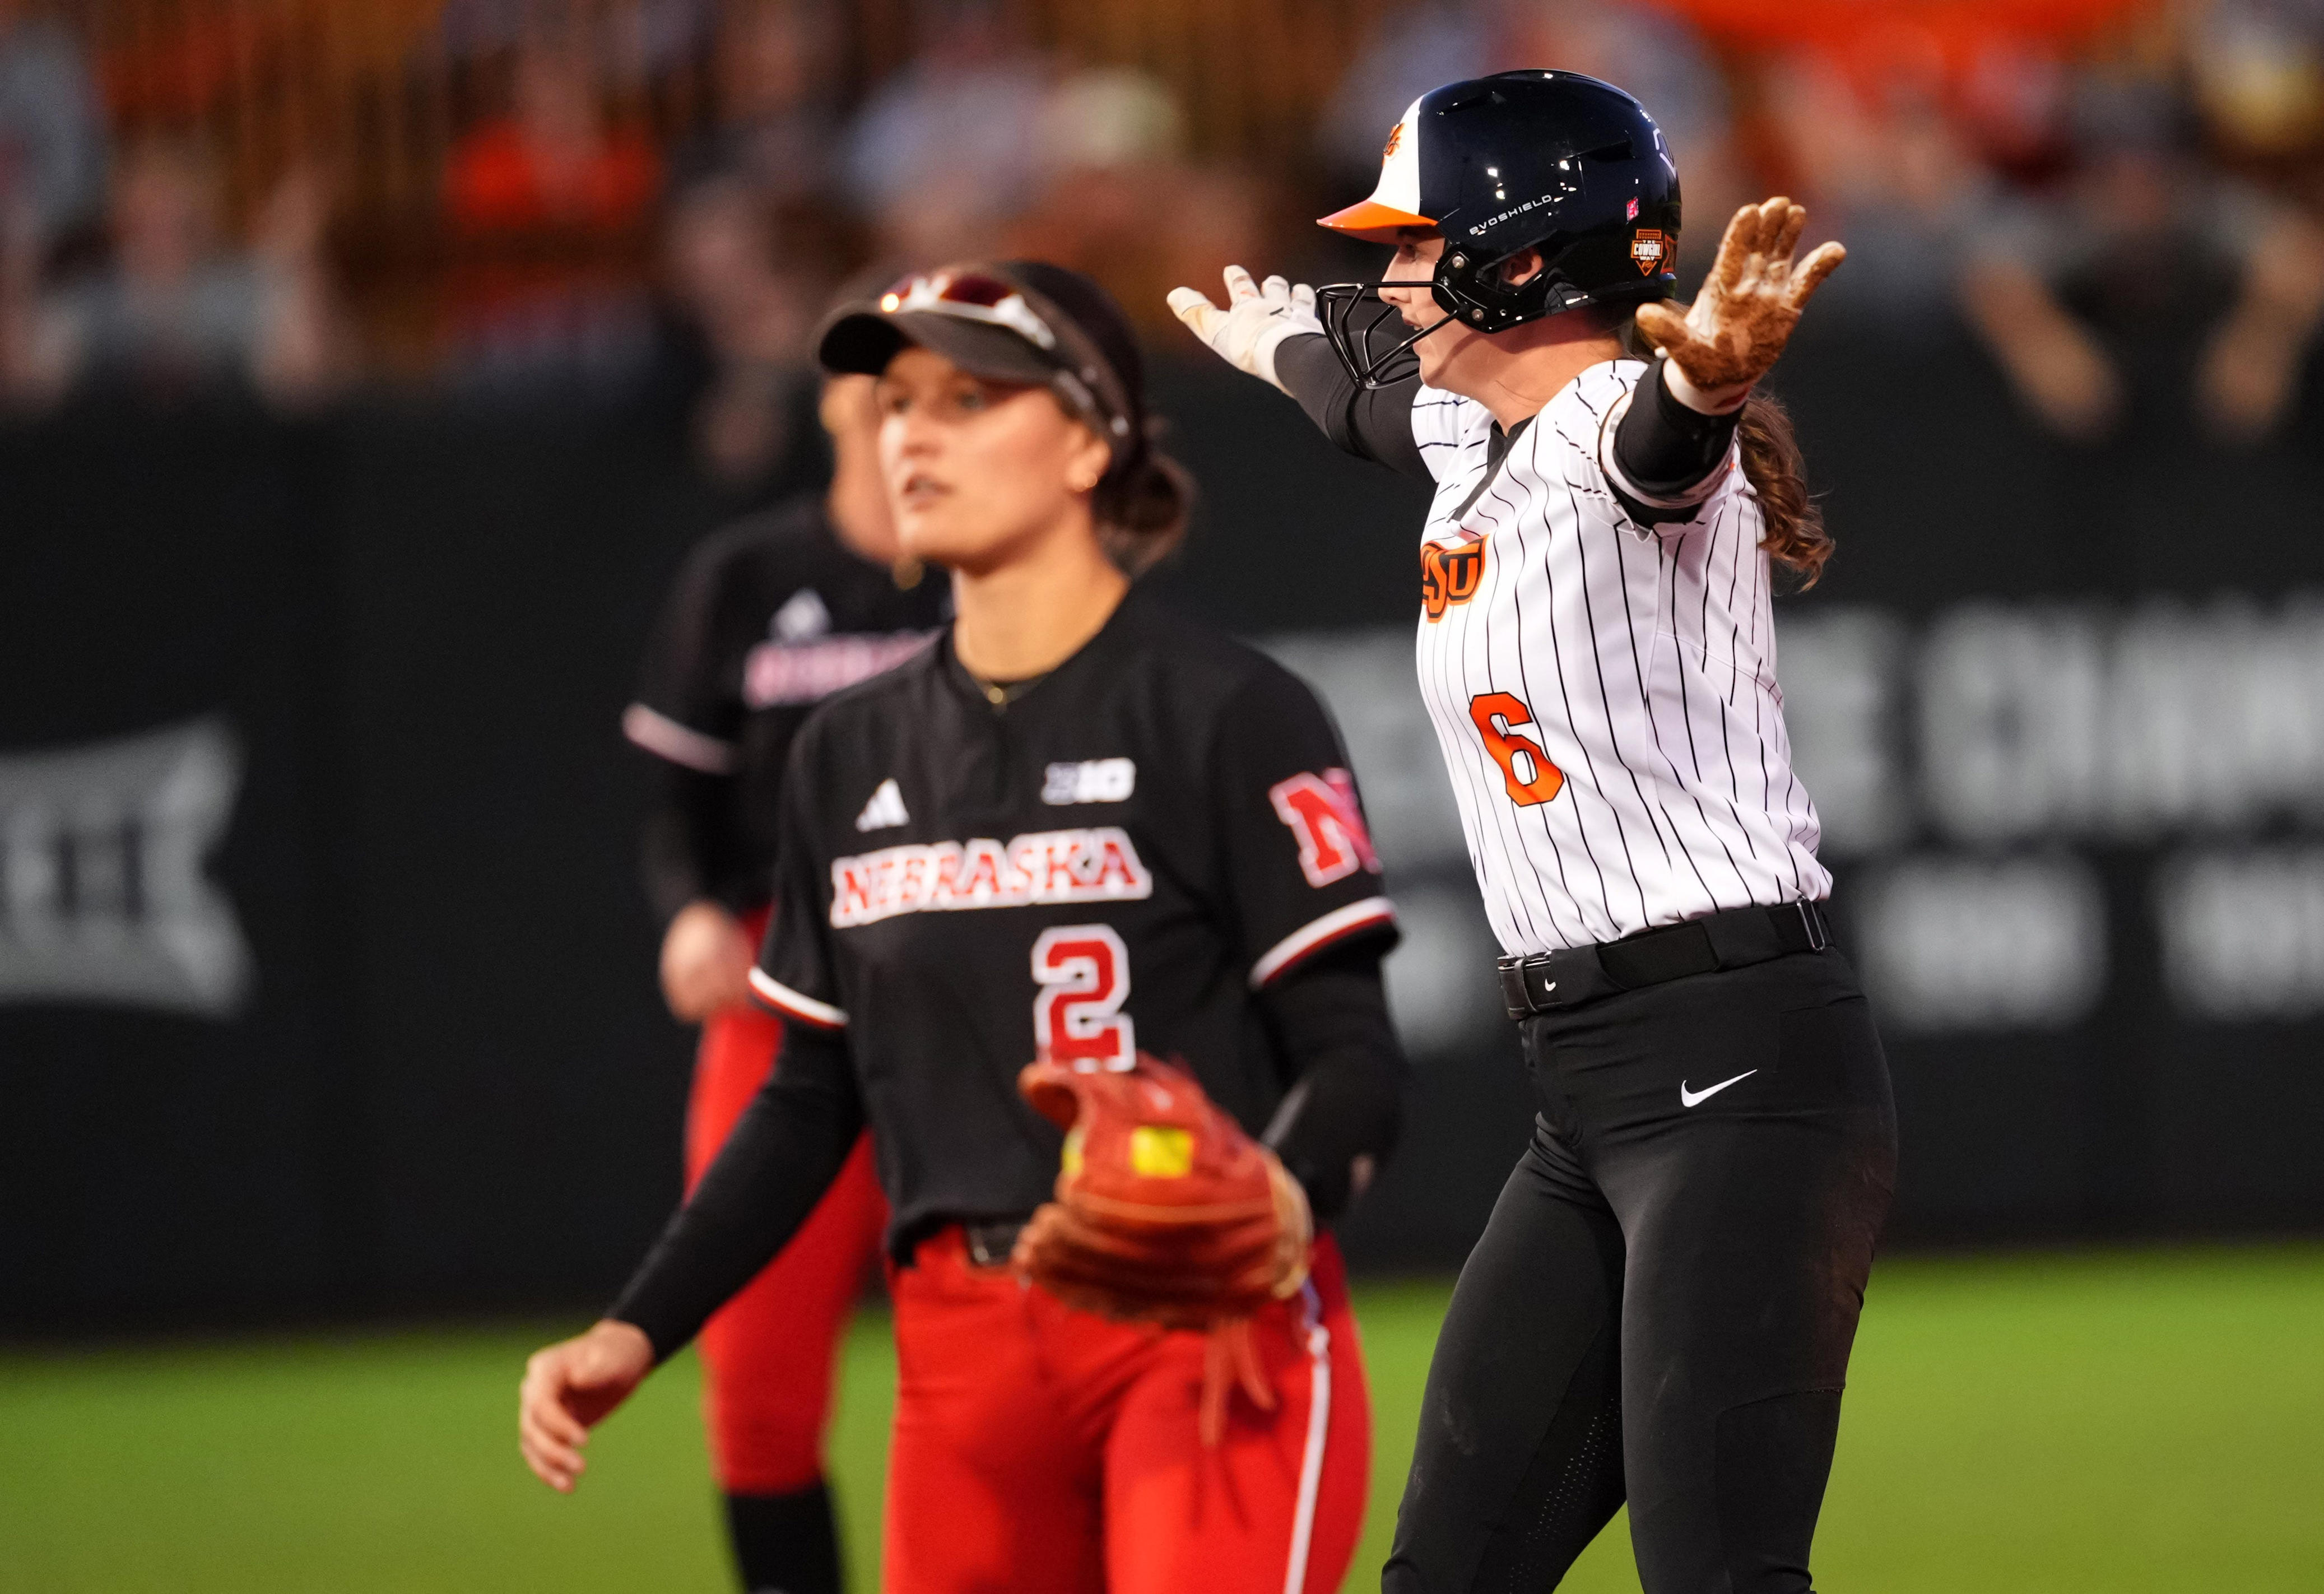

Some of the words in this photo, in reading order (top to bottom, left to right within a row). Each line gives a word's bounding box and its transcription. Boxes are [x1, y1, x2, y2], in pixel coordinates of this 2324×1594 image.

[1633, 243, 1661, 256] COWGIRL
[1468, 691, 1565, 807] 6
[830, 826, 1152, 929] NEBRASKA
[1267, 767, 1383, 889] N
[1031, 923, 1136, 1073] 2
